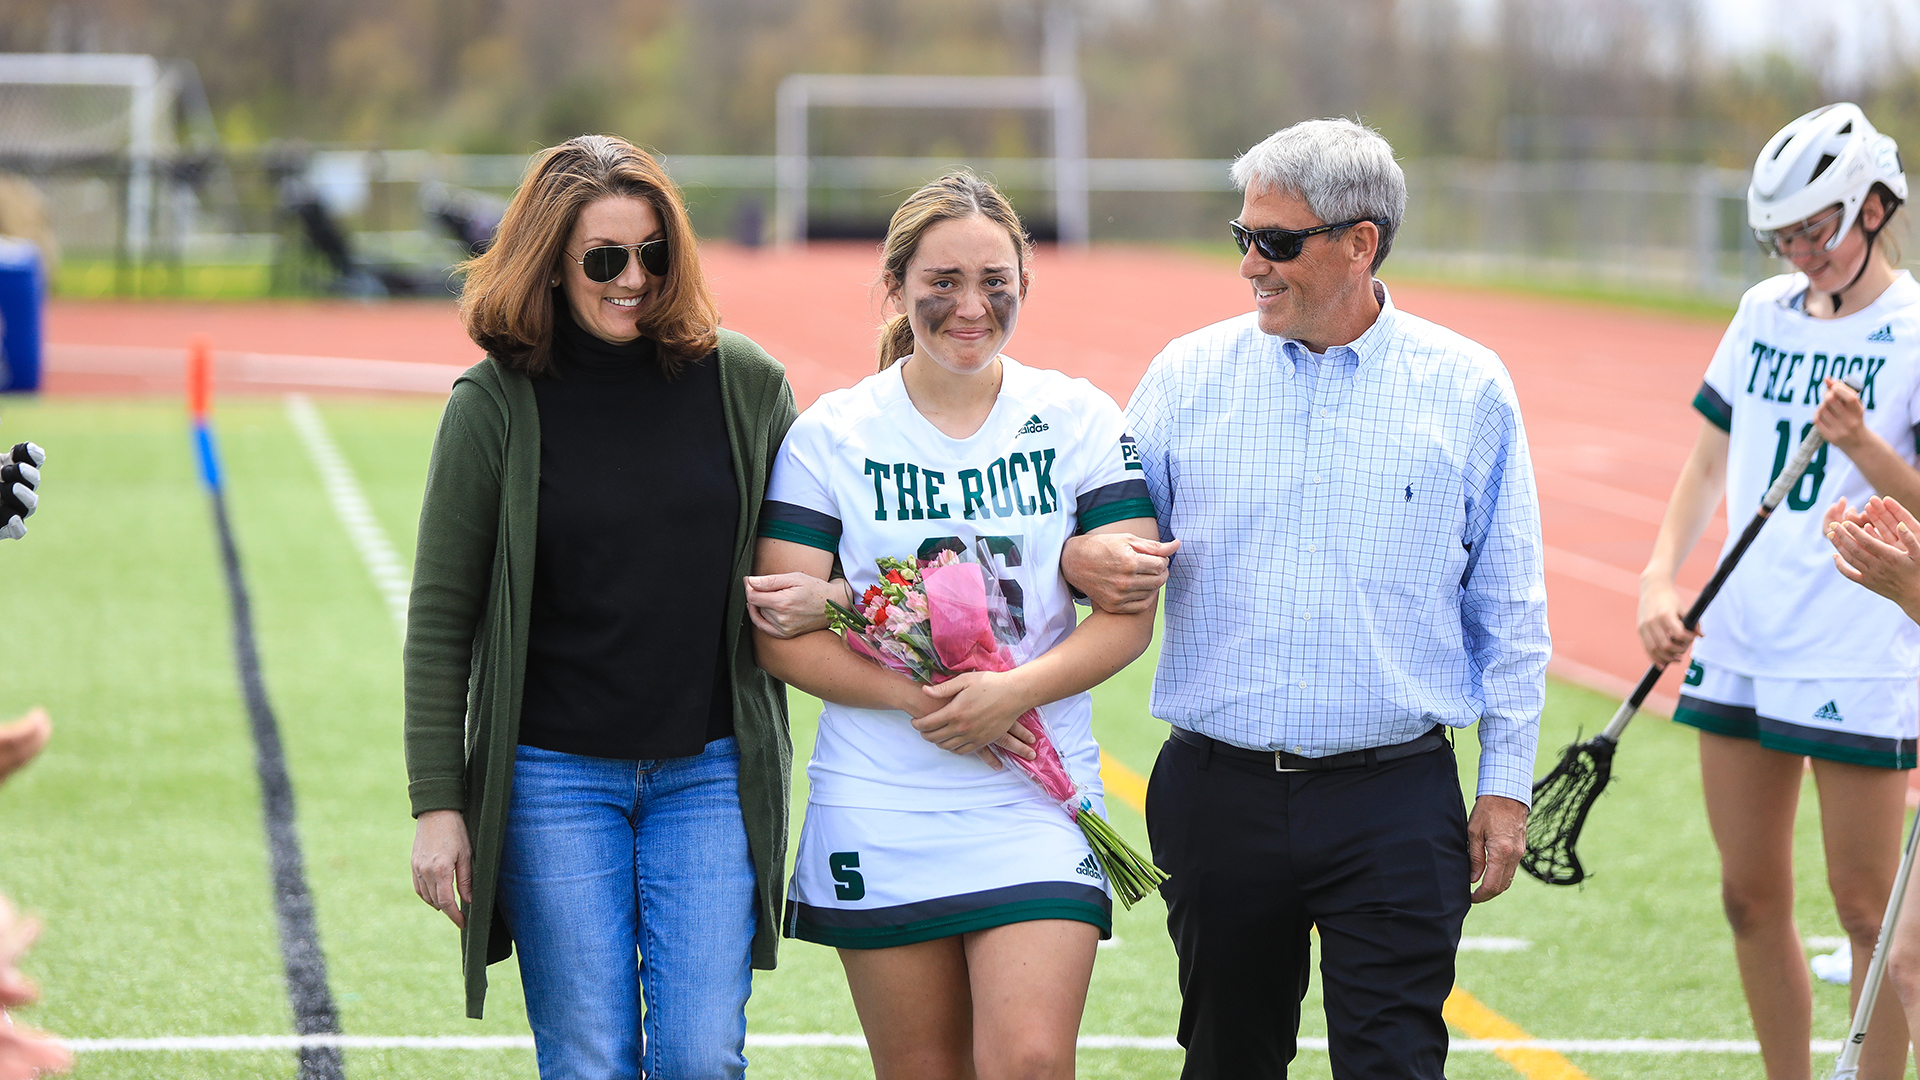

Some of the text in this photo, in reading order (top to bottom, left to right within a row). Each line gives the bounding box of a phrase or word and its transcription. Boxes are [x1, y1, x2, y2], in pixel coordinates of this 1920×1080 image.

[1747, 341, 1804, 403] THE
[864, 447, 1058, 521] THE ROCK
[1760, 420, 1828, 511] 18
[916, 534, 1026, 646] 5
[829, 851, 866, 901] S
